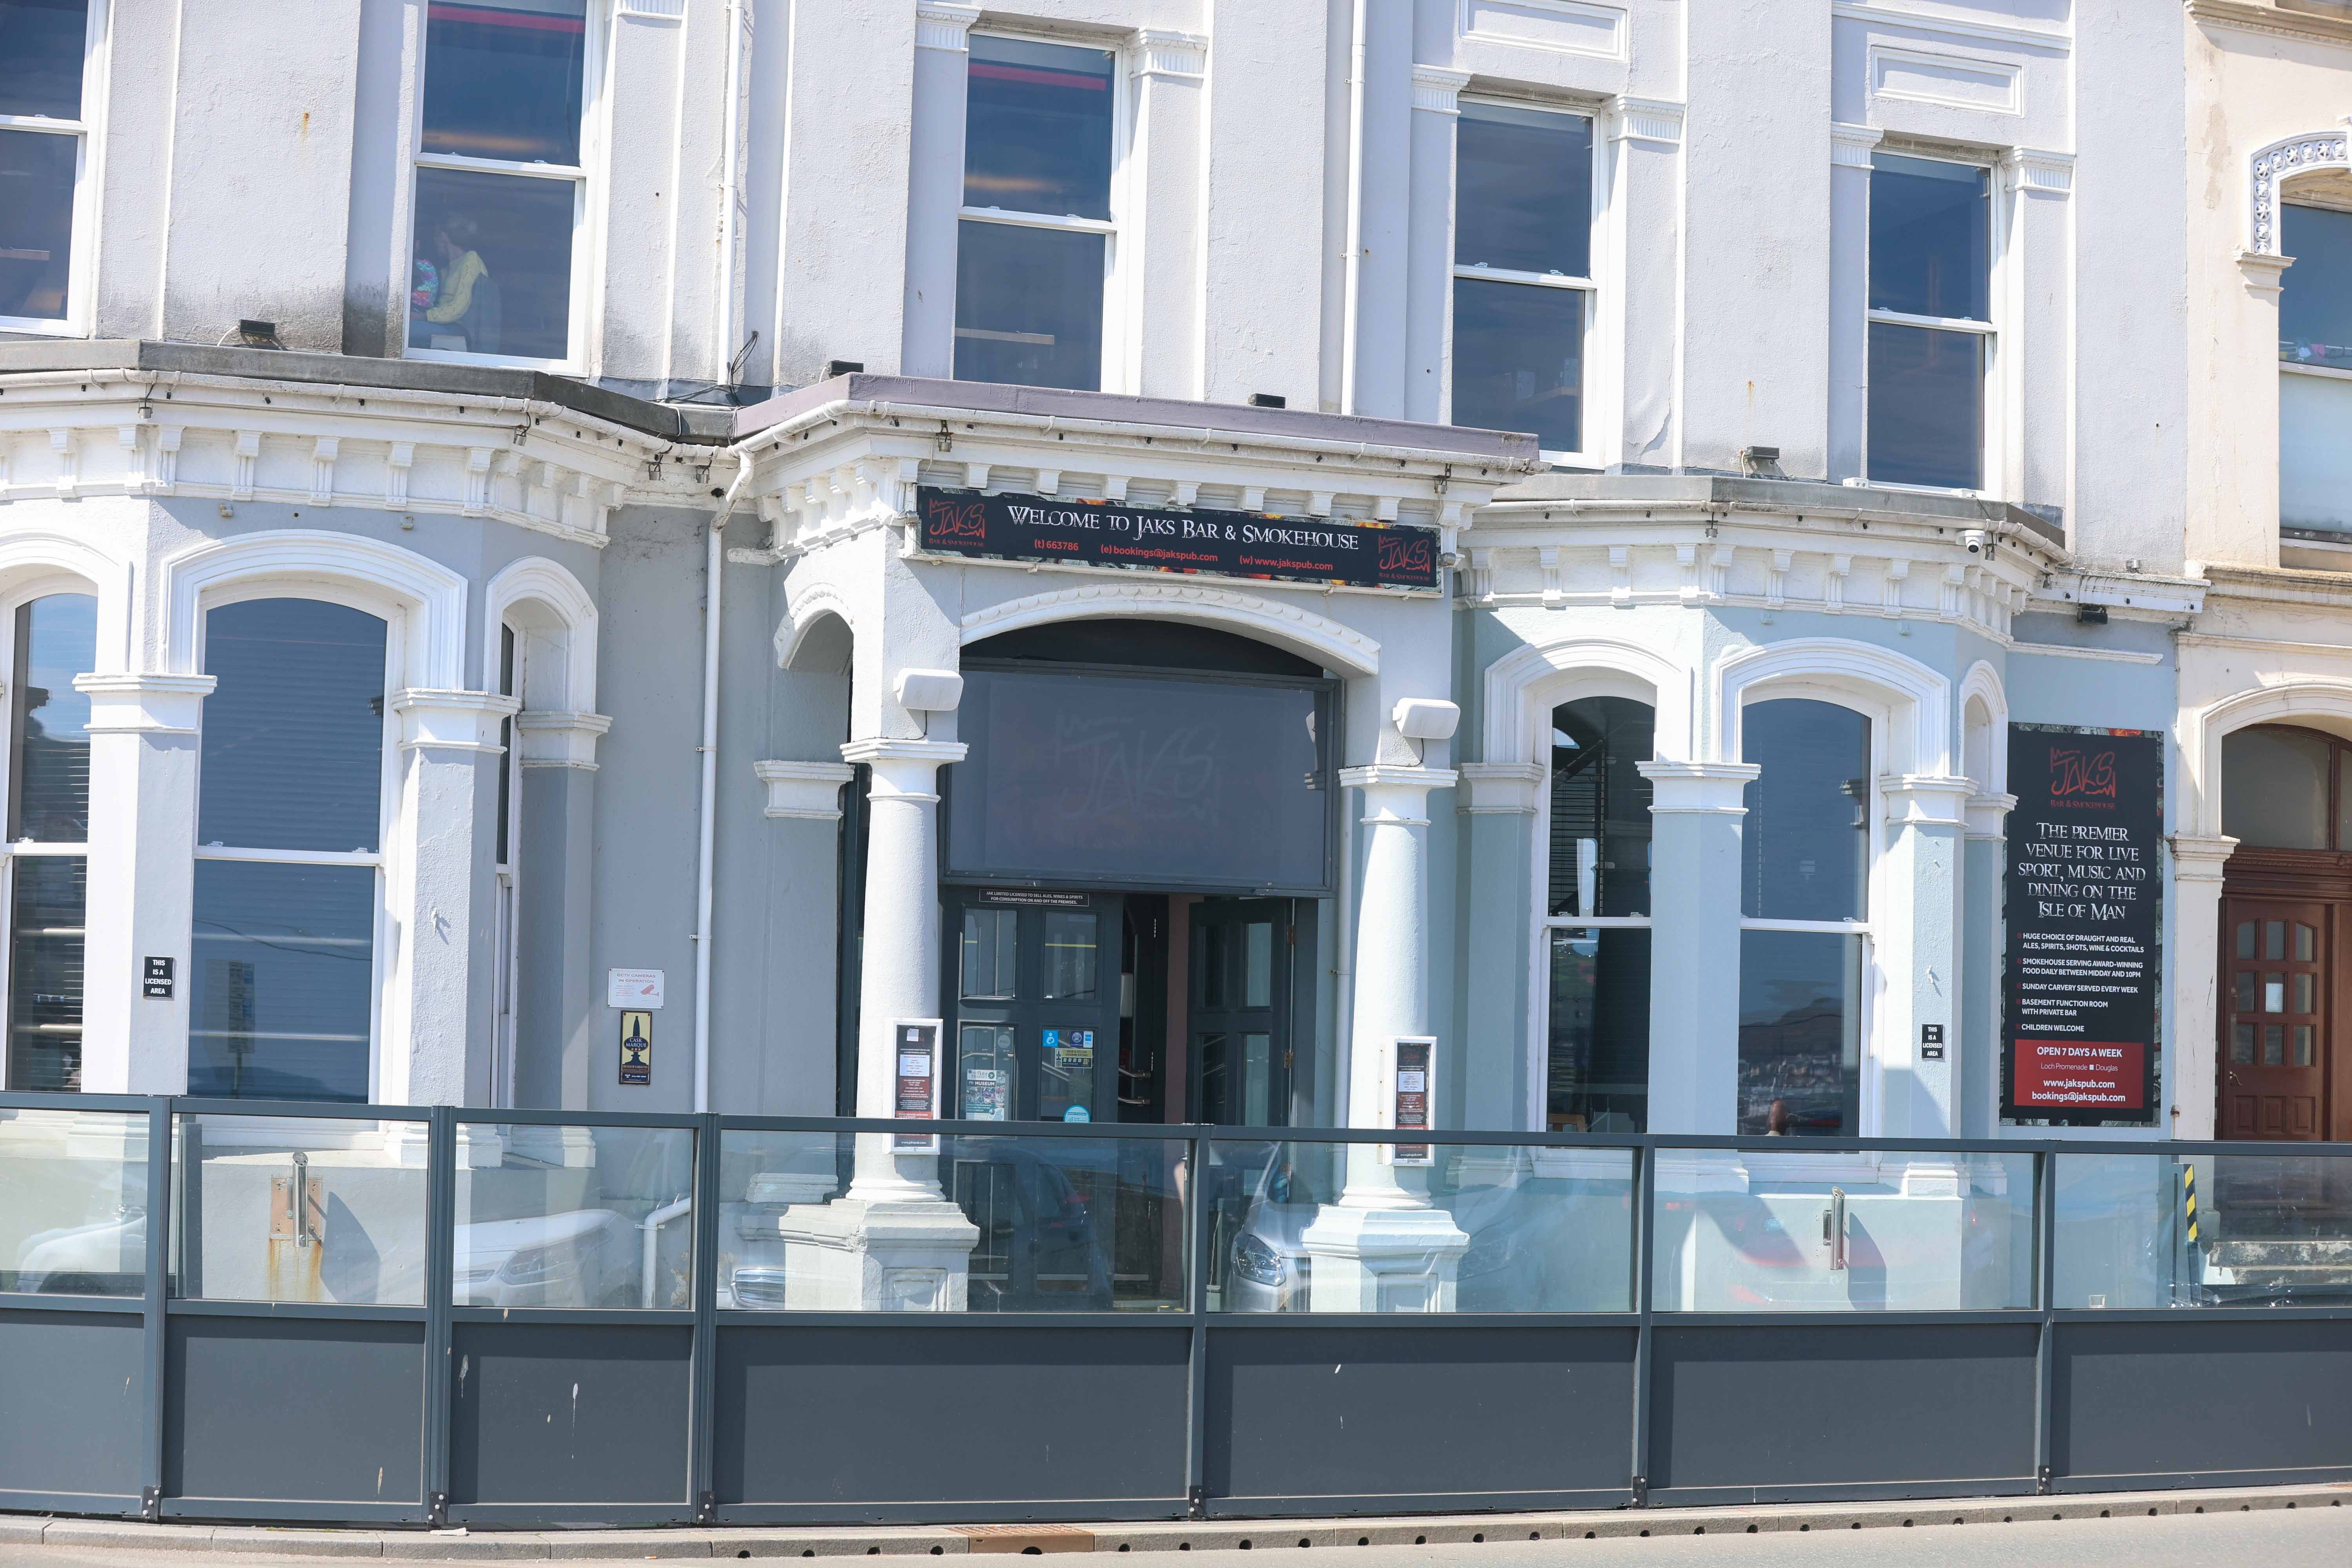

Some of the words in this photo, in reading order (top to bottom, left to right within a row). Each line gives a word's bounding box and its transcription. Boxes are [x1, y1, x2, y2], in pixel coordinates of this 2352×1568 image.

[929, 501, 985, 537] JAKS
[1007, 506, 1099, 529] WELCOME
[1107, 515, 1129, 530] TO
[1132, 515, 1175, 540] JAKS
[1182, 520, 1219, 539] BAR
[1225, 525, 1236, 540] &
[1243, 525, 1359, 550] SMOKEHOUSE
[1034, 539, 1044, 549] (t)
[1046, 540, 1079, 551] 663786
[1101, 544, 1112, 555] (e)
[1114, 545, 1218, 561] bookings@jakspub.com
[1379, 537, 1430, 571] JAKS
[1240, 555, 1253, 565] (w)
[1255, 557, 1332, 570] www.jakspub.com
[2051, 750, 2116, 796] JAKS
[2036, 822, 2067, 839] THE
[2071, 826, 2129, 841] PREMIER
[2025, 843, 2072, 858] VENUE
[2076, 846, 2104, 860] FOR
[2109, 847, 2139, 861] LIVE
[2018, 862, 2063, 882] SPORT,
[2068, 865, 2111, 880] MUSIC
[2115, 867, 2145, 881] AND
[2027, 883, 2078, 898] DINING
[2083, 885, 2103, 899] ON
[2108, 886, 2136, 900] THE
[2038, 901, 2064, 918] ISLE
[2068, 904, 2085, 918] OF
[2091, 903, 2126, 920] MAN
[2037, 1047, 2060, 1056] OPEN
[2068, 1048, 2090, 1056] DAYS
[2098, 1049, 2122, 1057] WEEK
[2043, 1079, 2115, 1089] www.jakspub.com
[2032, 1091, 2125, 1103] bookings@jakspub.com
